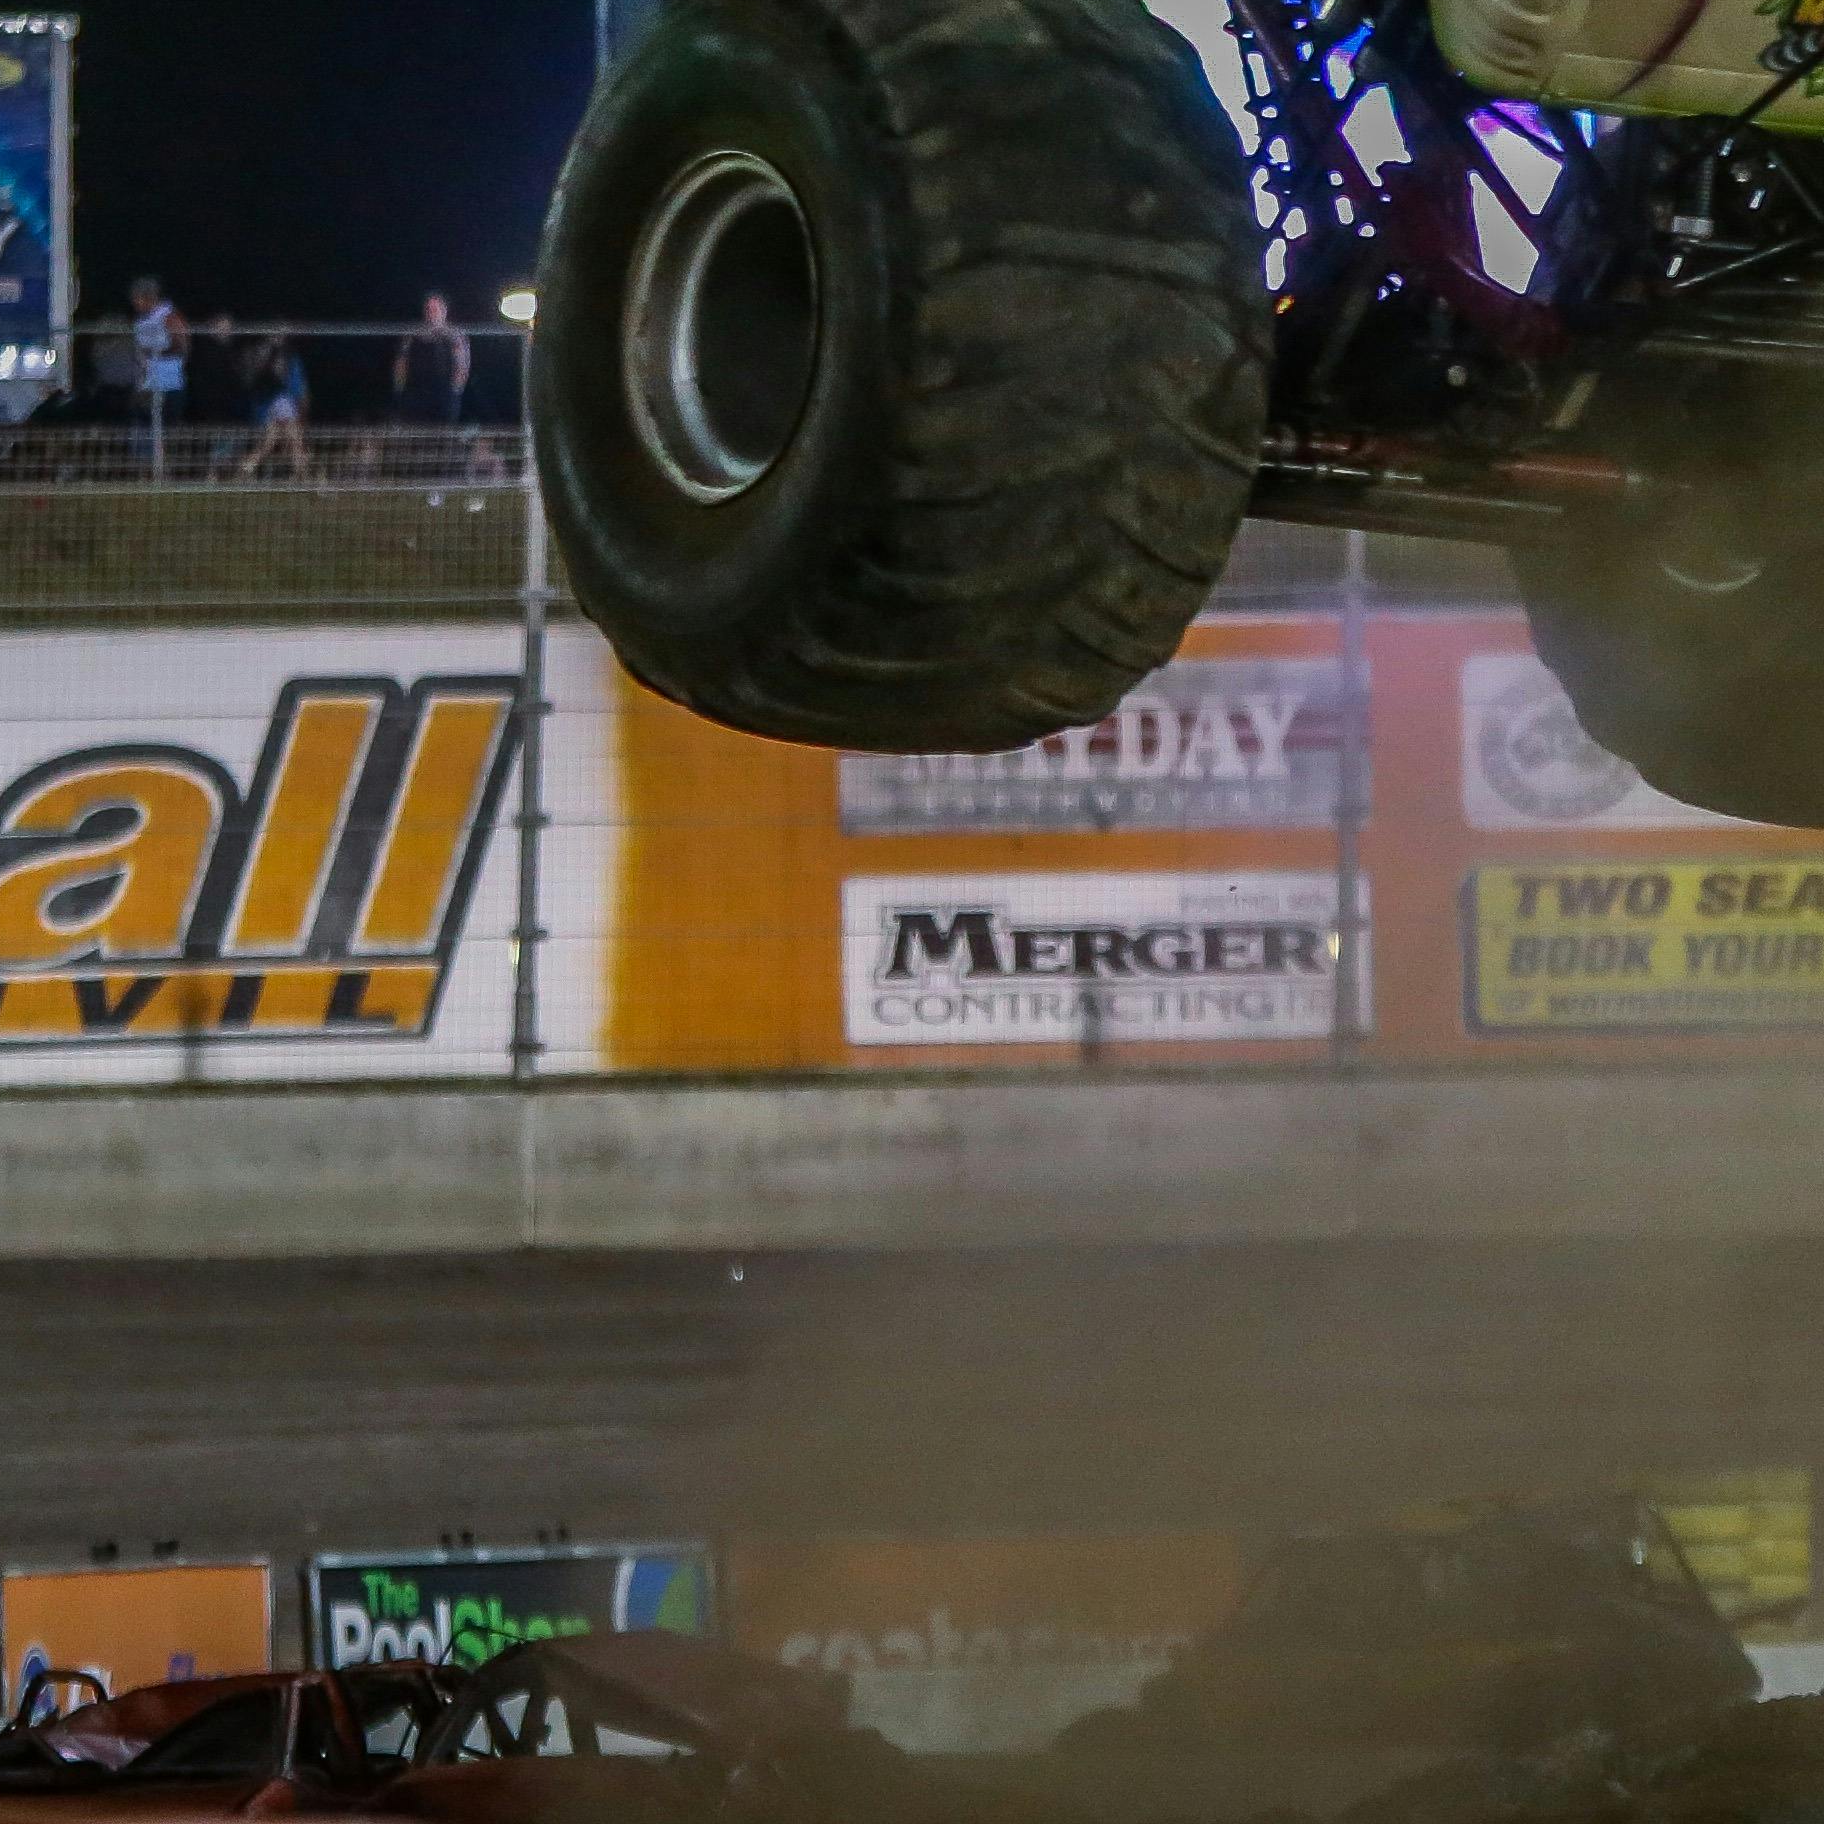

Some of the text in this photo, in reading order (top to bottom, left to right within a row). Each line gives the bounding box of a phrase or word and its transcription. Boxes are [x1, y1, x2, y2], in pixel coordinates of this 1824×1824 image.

[1512, 872, 1673, 920] TWO
[884, 911, 1325, 979] MERGER
[1507, 932, 1656, 978] BOOK
[1683, 931, 1824, 977] YOUR
[360, 1570, 419, 1619] The
